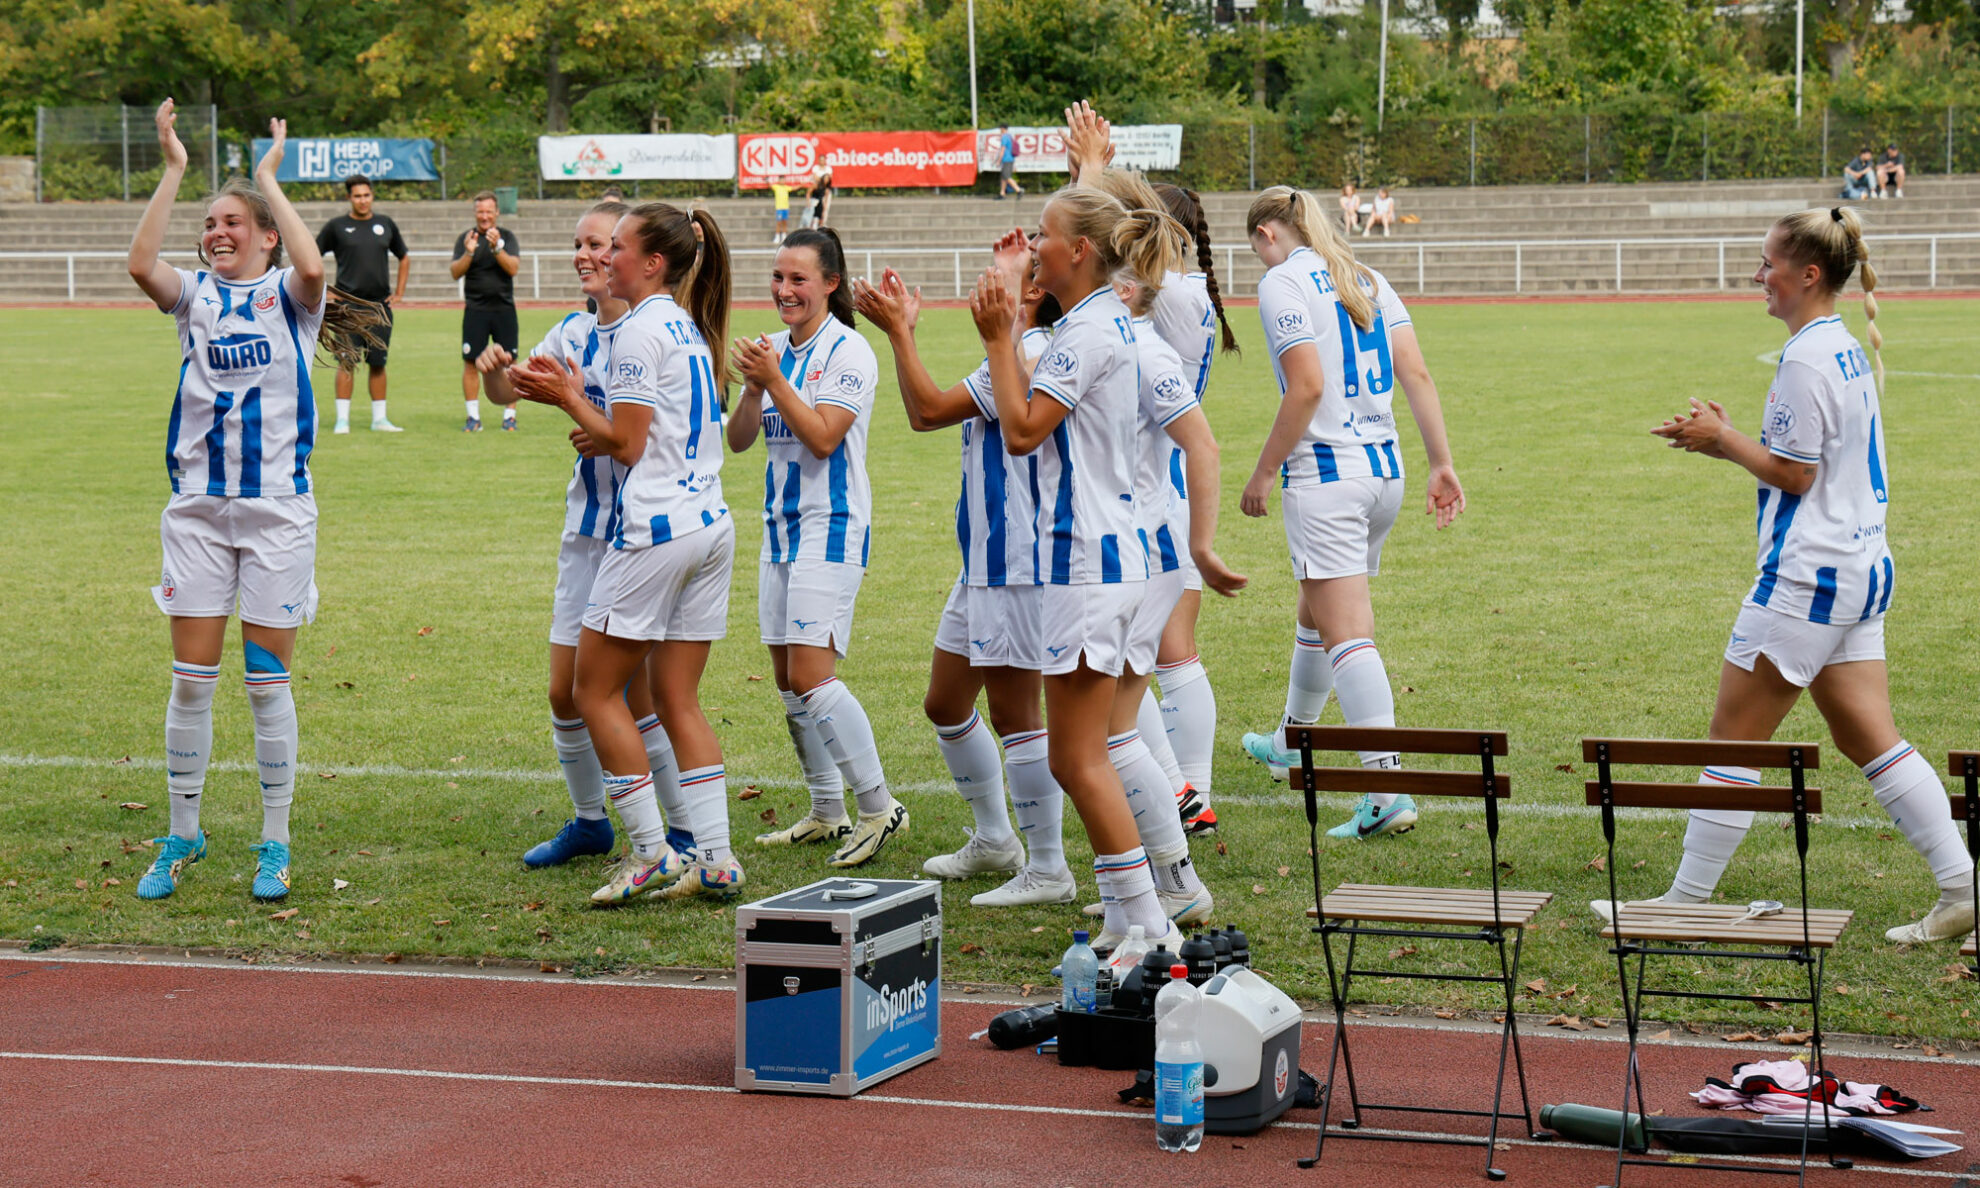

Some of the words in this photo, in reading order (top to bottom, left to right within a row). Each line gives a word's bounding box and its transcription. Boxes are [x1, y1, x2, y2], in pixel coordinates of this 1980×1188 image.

[334, 141, 380, 159] HEPA
[747, 145, 808, 168] KNS
[826, 148, 974, 170] abtec-shop.com
[334, 159, 393, 177] GROUP
[1277, 313, 1302, 328] FSN
[207, 340, 272, 371] WIRO
[619, 363, 643, 377] FSN
[840, 374, 863, 390] FSN
[1154, 375, 1180, 397] FSN
[763, 415, 793, 438] WIR
[866, 976, 927, 1032] inSports
